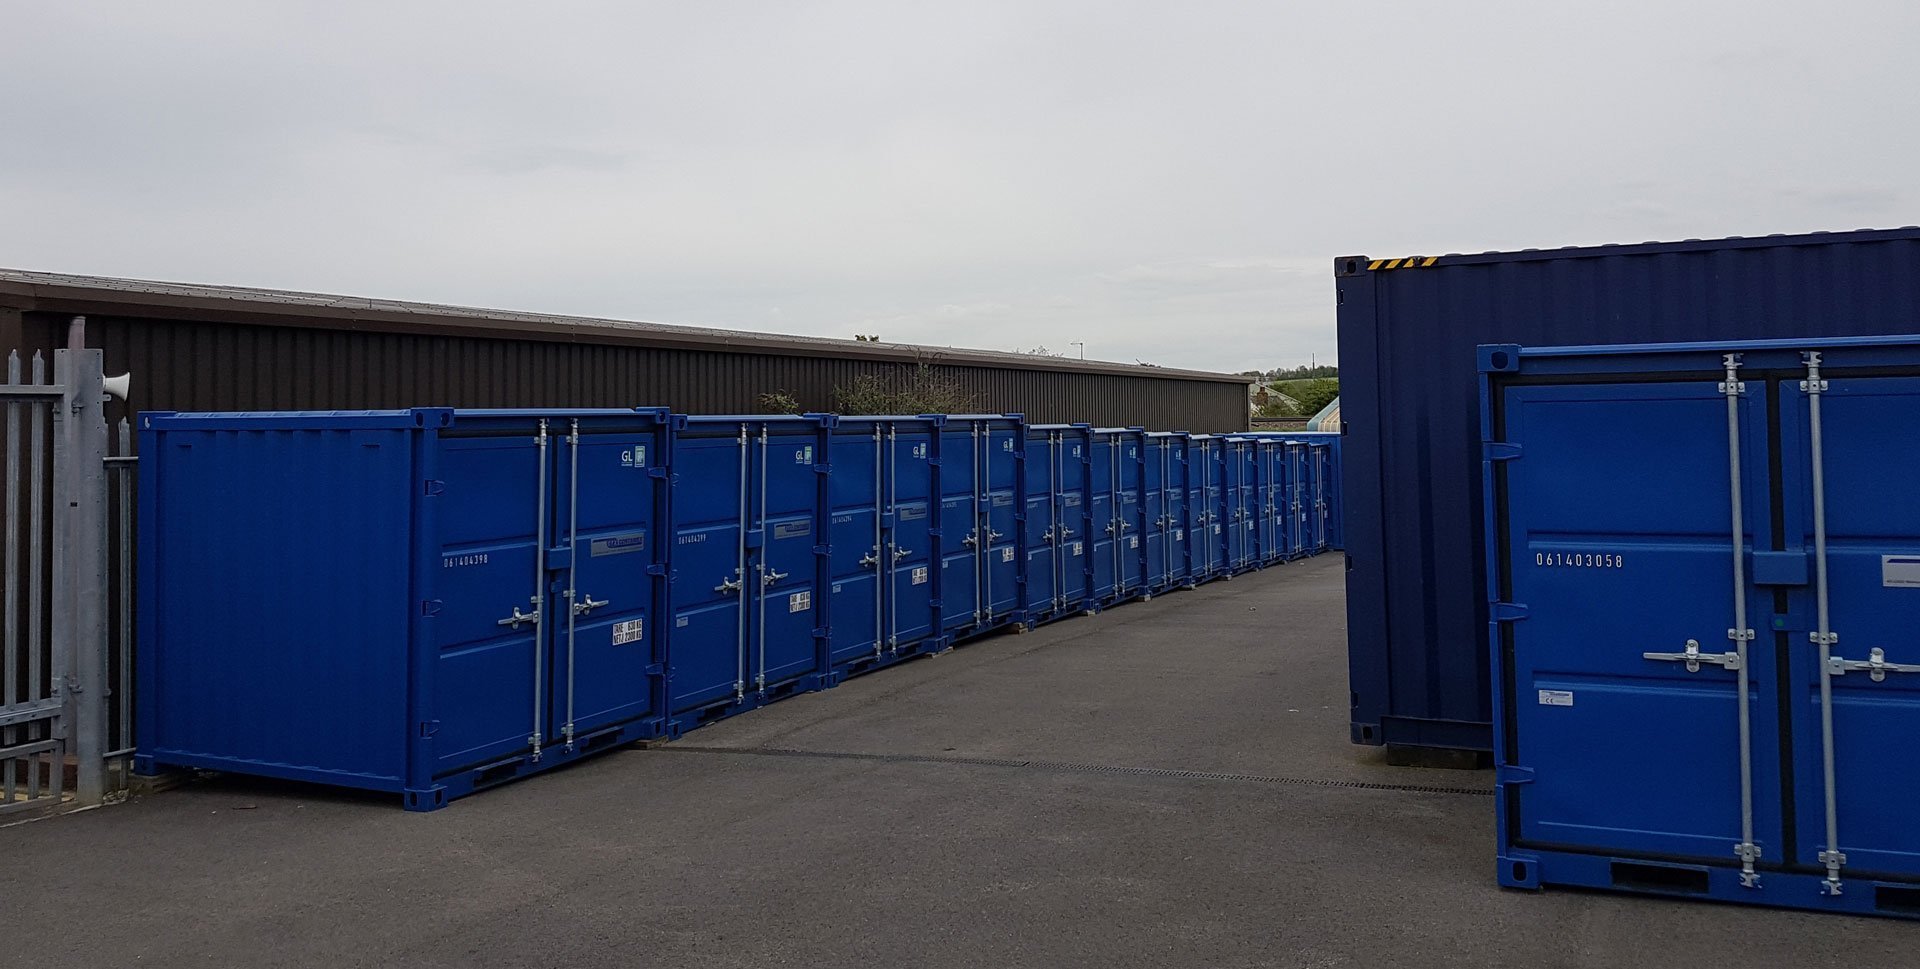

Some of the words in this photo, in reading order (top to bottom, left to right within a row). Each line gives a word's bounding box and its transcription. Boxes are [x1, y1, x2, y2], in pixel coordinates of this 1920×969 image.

[621, 450, 633, 462] GL
[443, 554, 488, 568] 061404398
[1536, 552, 1622, 568] 061403058
